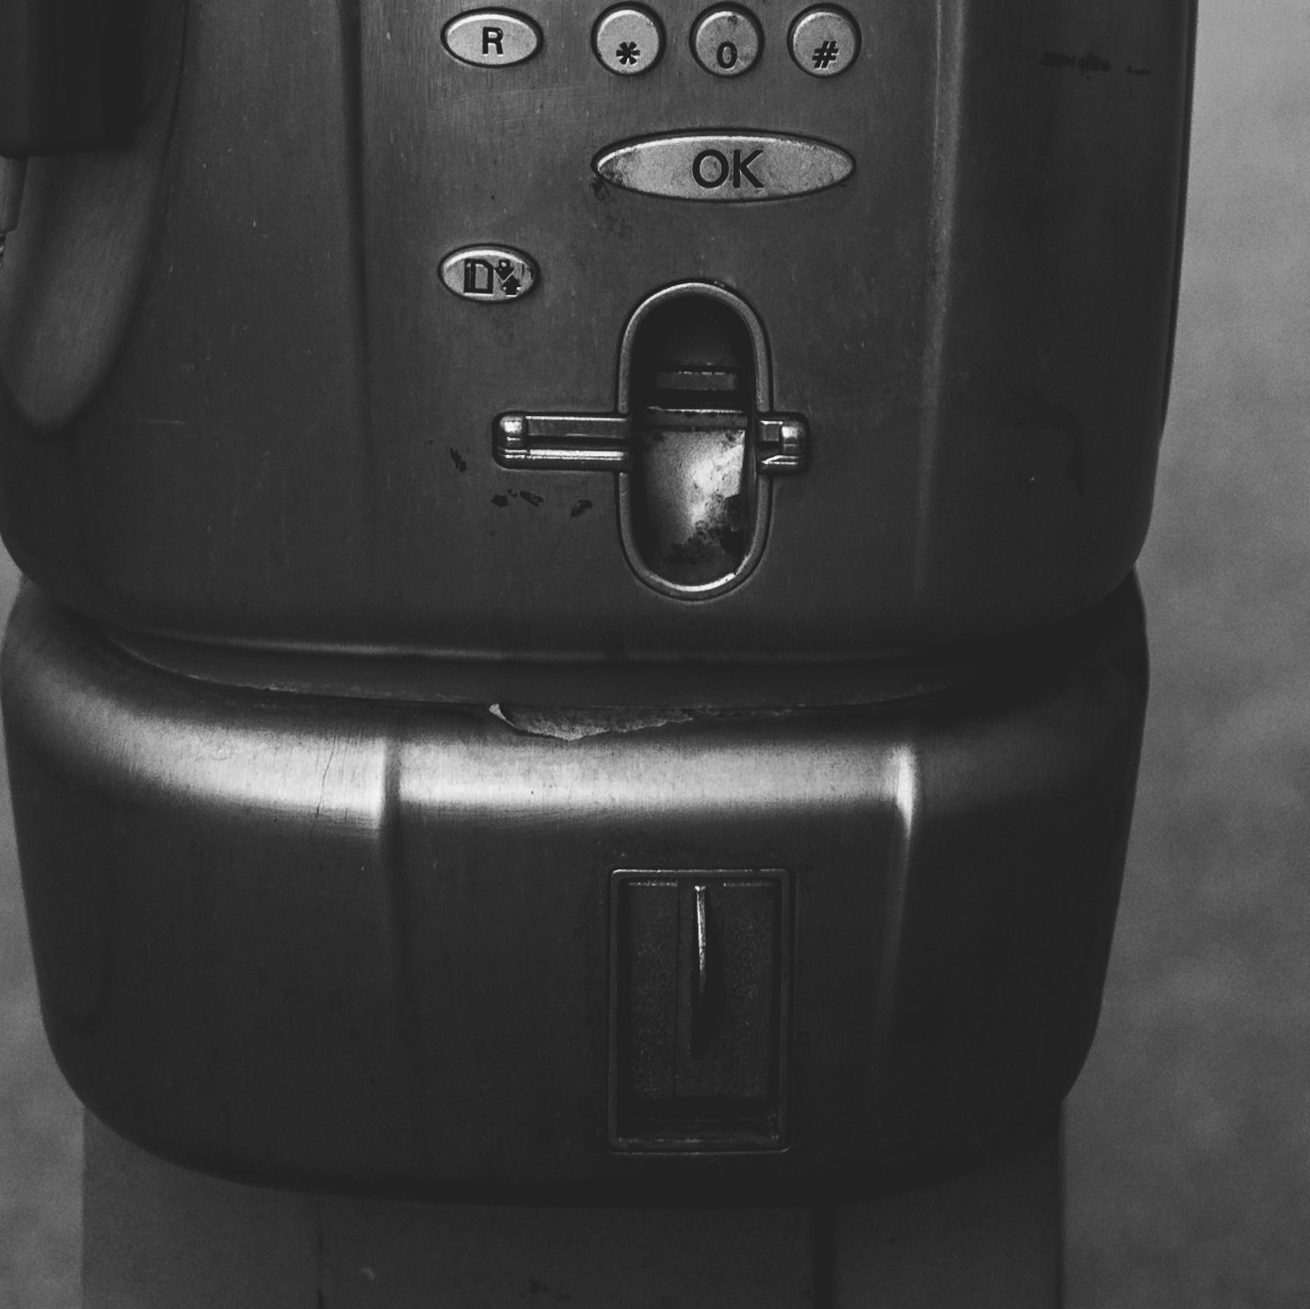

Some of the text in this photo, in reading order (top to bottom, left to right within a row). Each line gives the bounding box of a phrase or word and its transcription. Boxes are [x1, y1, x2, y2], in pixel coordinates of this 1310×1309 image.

[481, 26, 504, 56] R
[716, 41, 738, 69] 0
[692, 149, 764, 189] OK
